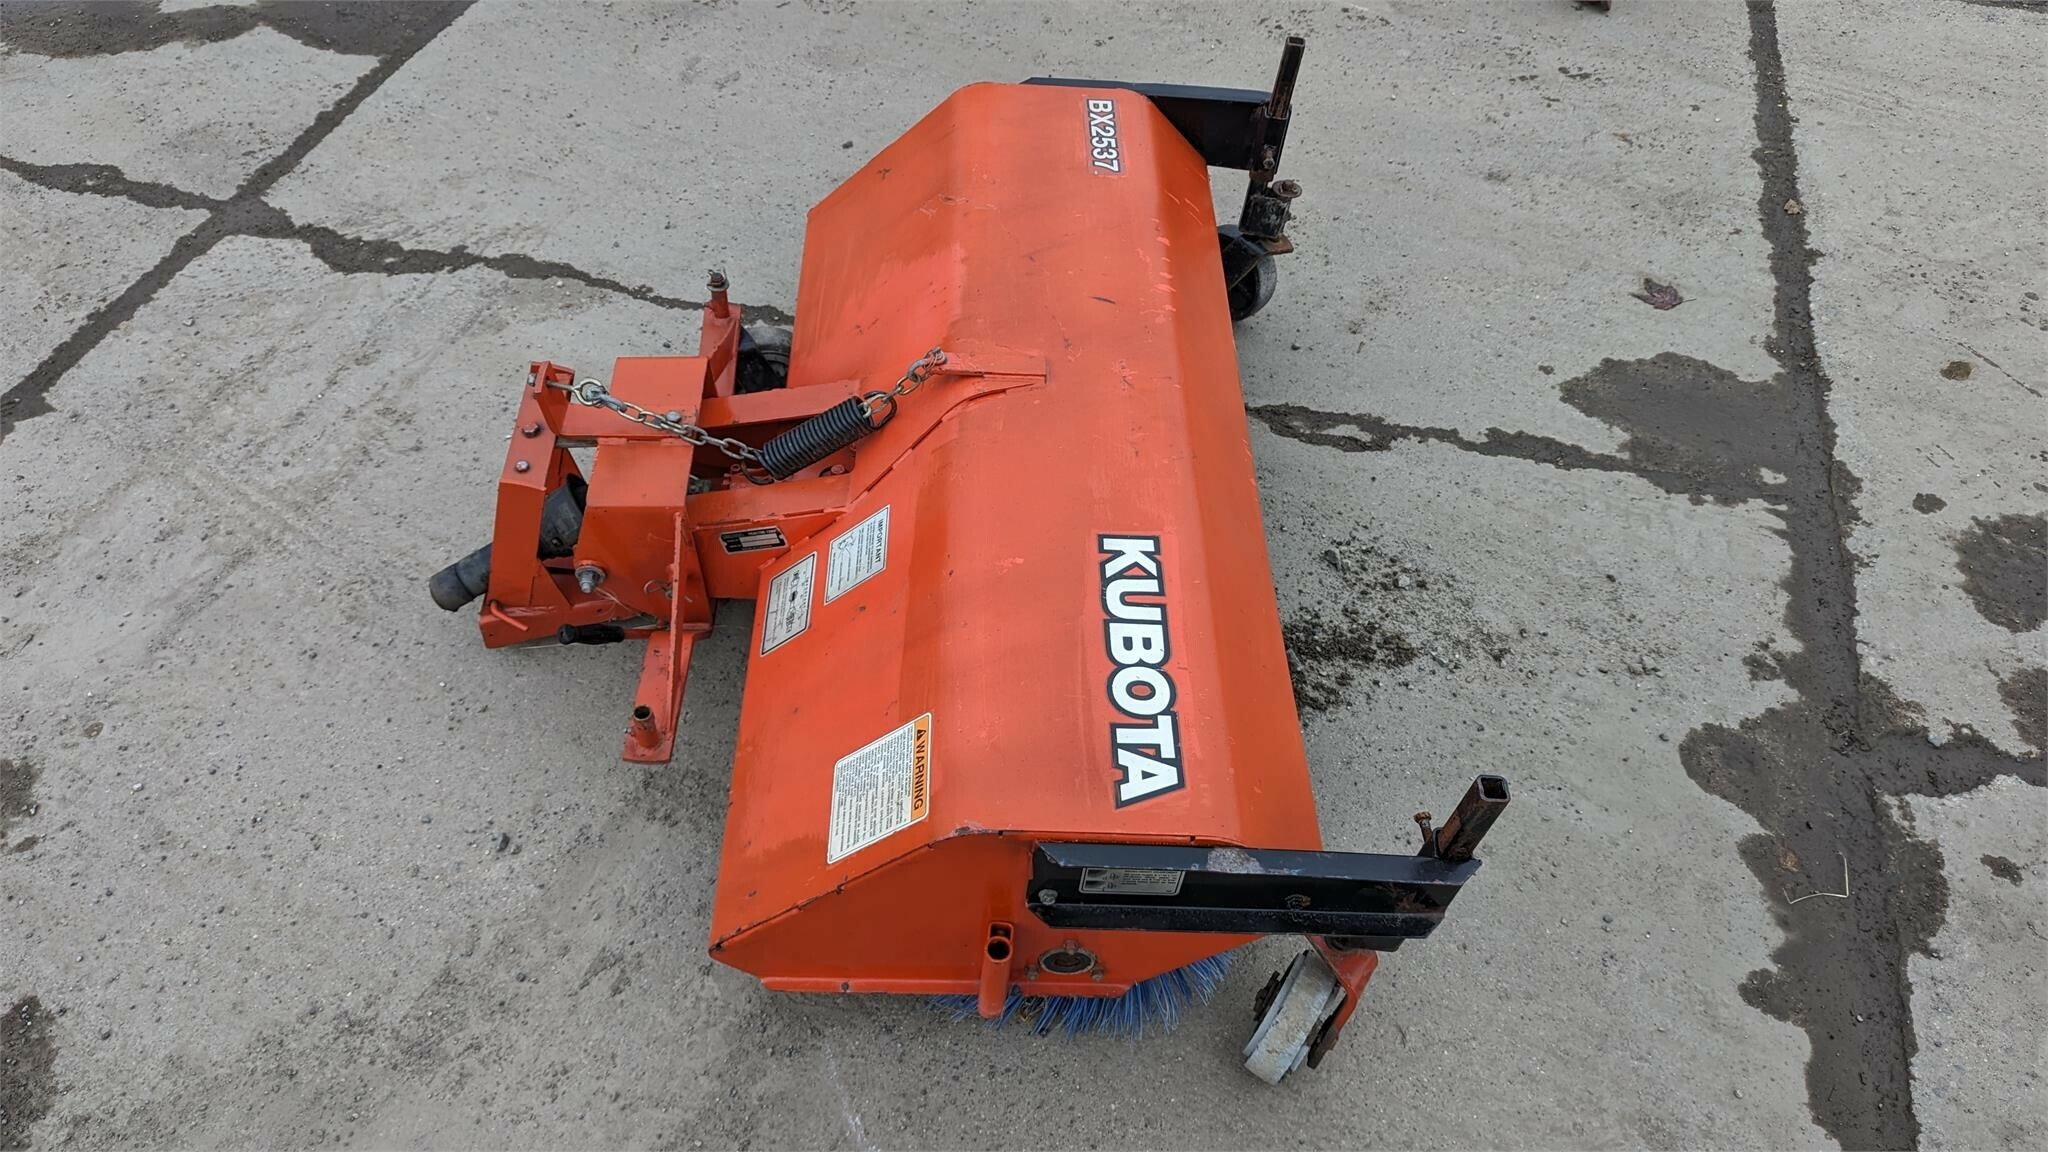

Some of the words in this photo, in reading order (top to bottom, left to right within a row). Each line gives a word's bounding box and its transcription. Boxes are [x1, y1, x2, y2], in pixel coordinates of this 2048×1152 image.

[1088, 99, 1120, 172] BX2537
[874, 518, 884, 563] IMPORTANT
[1100, 535, 1184, 807] KUBOTA
[913, 741, 926, 810] WARNING
